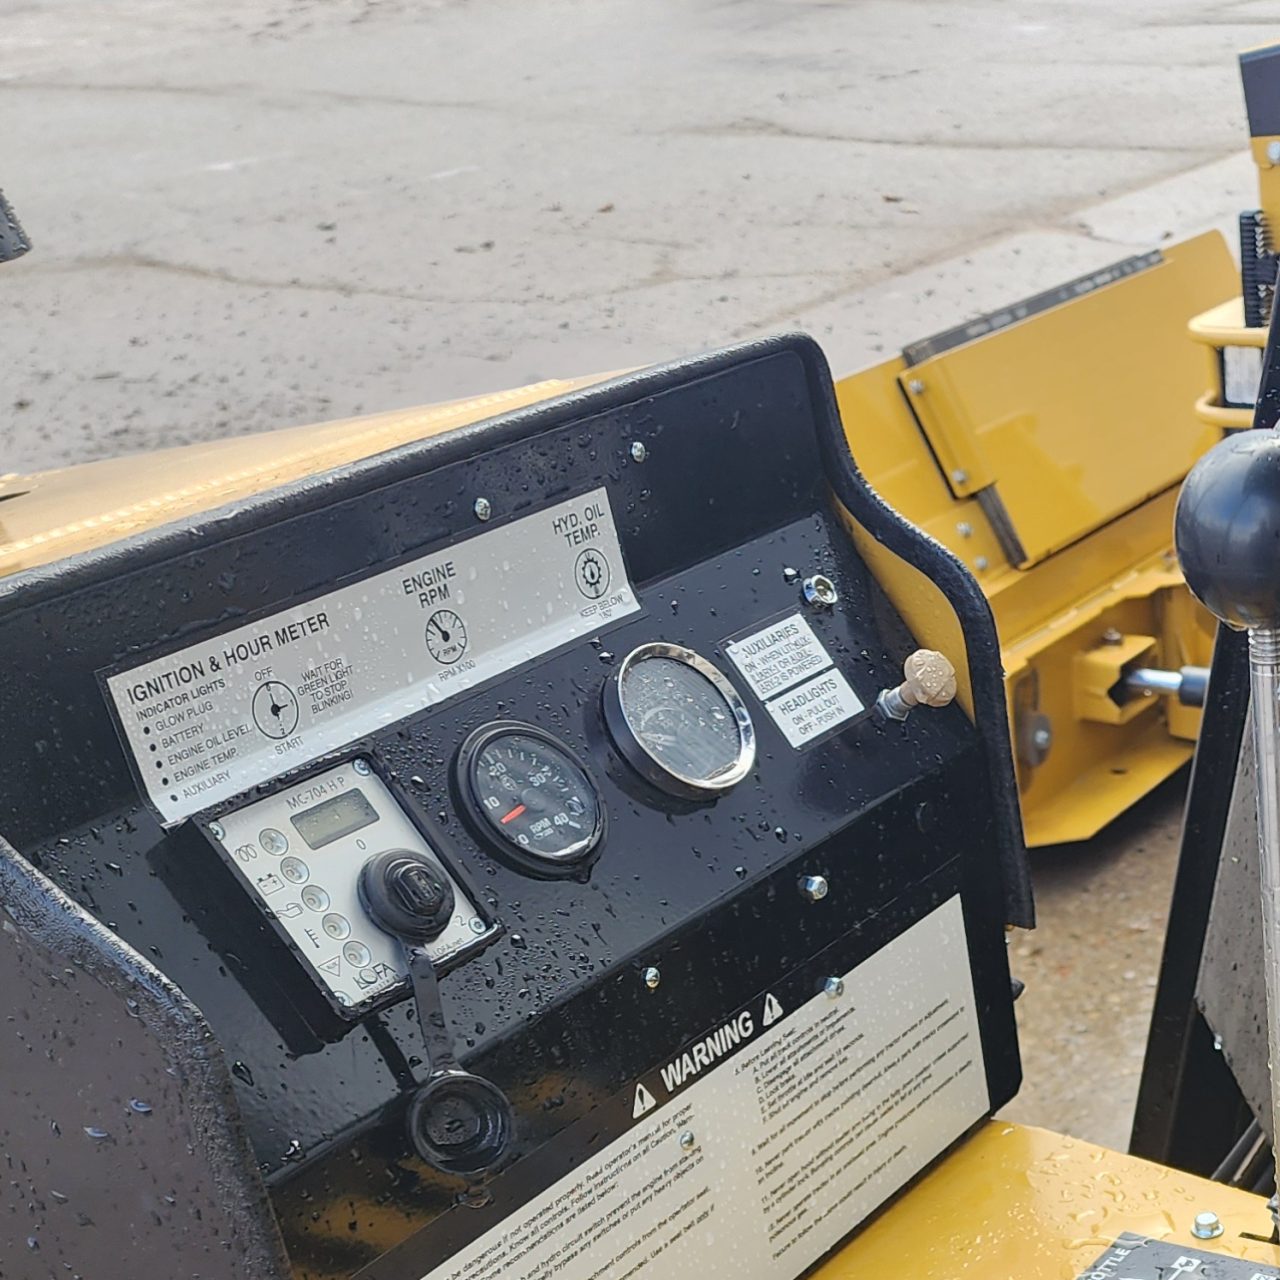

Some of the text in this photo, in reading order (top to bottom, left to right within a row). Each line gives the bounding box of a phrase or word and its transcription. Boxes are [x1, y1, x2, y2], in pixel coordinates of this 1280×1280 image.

[551, 502, 604, 535] HYD. OIL
[564, 522, 600, 548] TEMP.
[401, 561, 456, 595] ENGINE
[417, 583, 450, 608] RPM
[579, 592, 623, 618] KEEP BELOW
[739, 622, 800, 659] AUXILIARIES
[126, 611, 330, 705] IGNITION & HOUR METER
[300, 657, 343, 682] WAIT FOR
[438, 658, 475, 681] RPM X100
[253, 666, 274, 682] OFF
[296, 664, 354, 696] GREEN LIGHT
[135, 677, 226, 721] INDICATOR LIGHTS
[310, 679, 348, 702] TO STOP
[310, 688, 354, 714] BLINKING!
[777, 678, 838, 715] HEADLIGHTS
[154, 700, 213, 732] GLOW PLUG
[791, 694, 840, 725] ON PULL OUT
[797, 705, 845, 735] OFF PUSH IN
[160, 722, 206, 749] BATTERY
[167, 722, 251, 765] ENGINE OIL LEVEL
[274, 734, 304, 756] START
[173, 746, 239, 782] ENGINE TEMP.
[489, 763, 506, 776] 20
[182, 769, 231, 799] AUXILIARY
[529, 773, 546, 786] 30
[286, 784, 327, 810] MC-704
[483, 796, 500, 810] 10
[529, 818, 551, 833] RPM
[554, 813, 569, 826] 40
[660, 1011, 754, 1092] WARNING
[462, 1238, 502, 1274] dangerous
[509, 1223, 522, 1240] not
[522, 1201, 554, 1231] operated
[554, 1178, 584, 1208] properly.
[603, 1140, 637, 1172] operator's
[661, 1115, 672, 1130] for
[671, 1100, 692, 1123] proper
